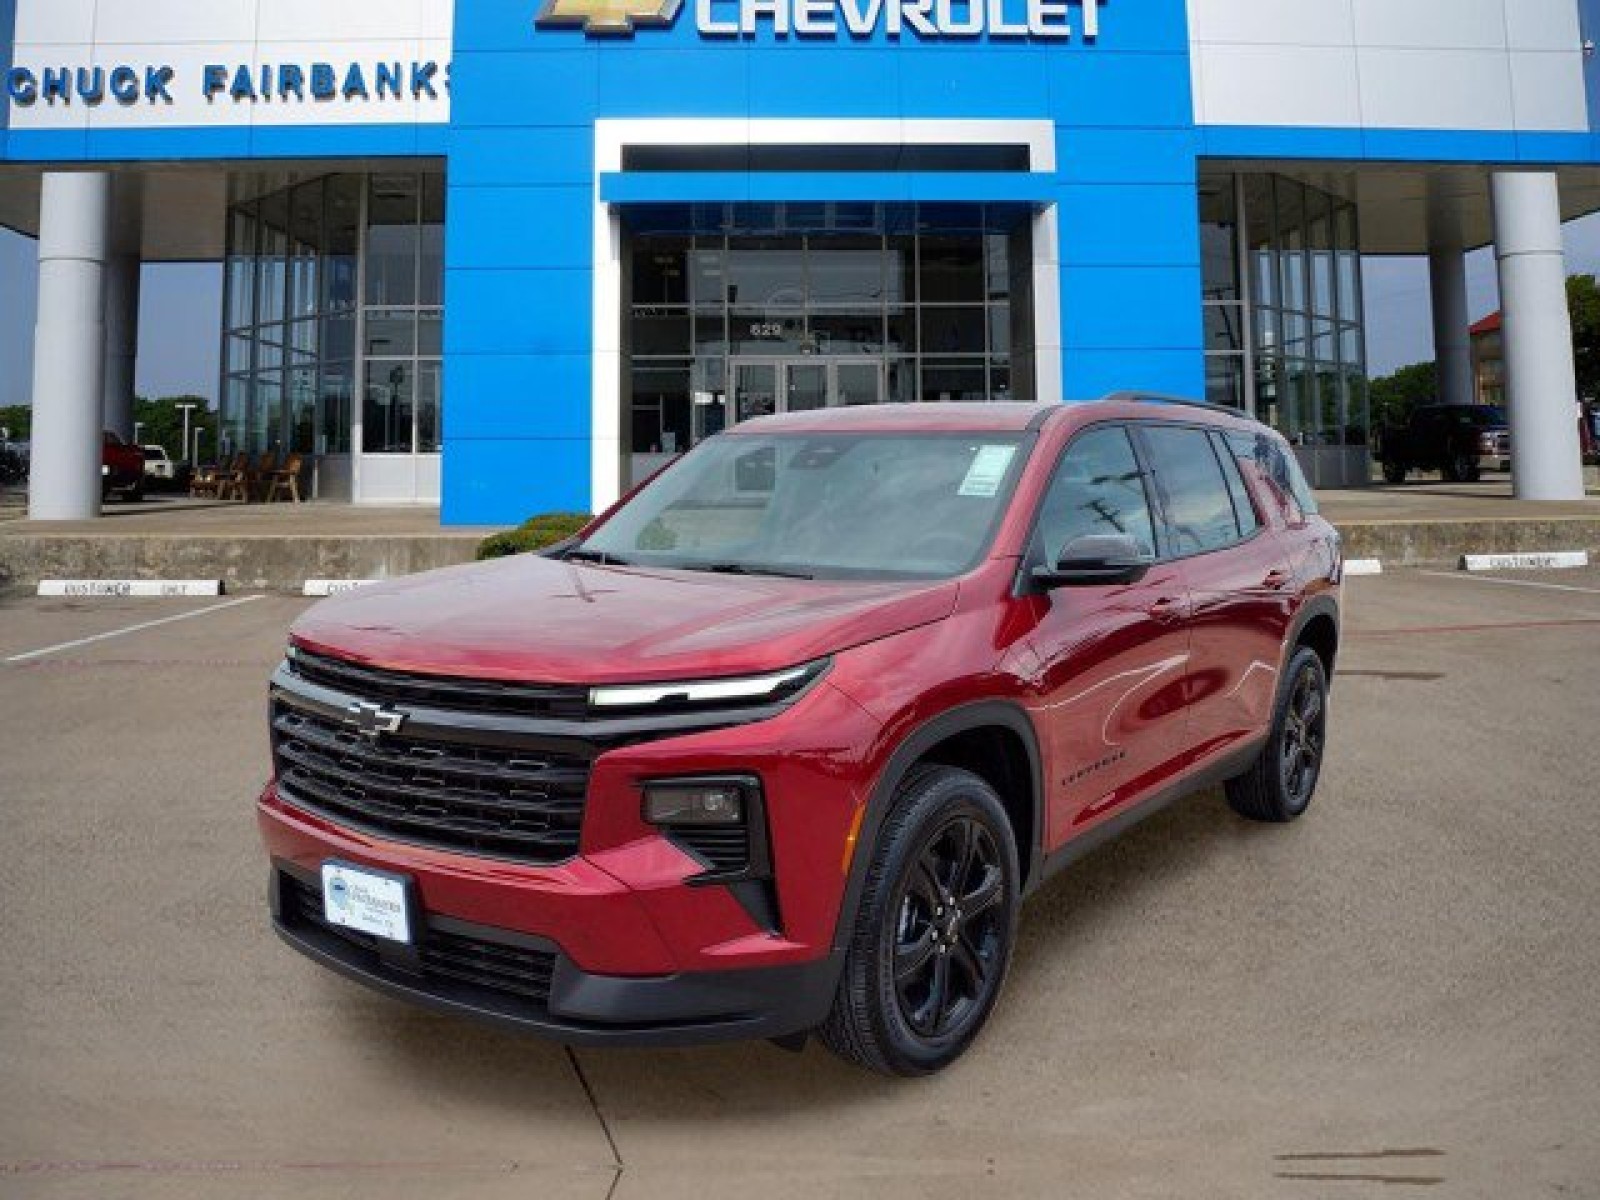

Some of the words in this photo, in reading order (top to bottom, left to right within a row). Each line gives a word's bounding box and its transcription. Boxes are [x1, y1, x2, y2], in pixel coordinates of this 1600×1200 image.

[695, 0, 1099, 38] CHEVROLET
[8, 65, 175, 107] CHUCK
[202, 61, 450, 104] FAIRBANK
